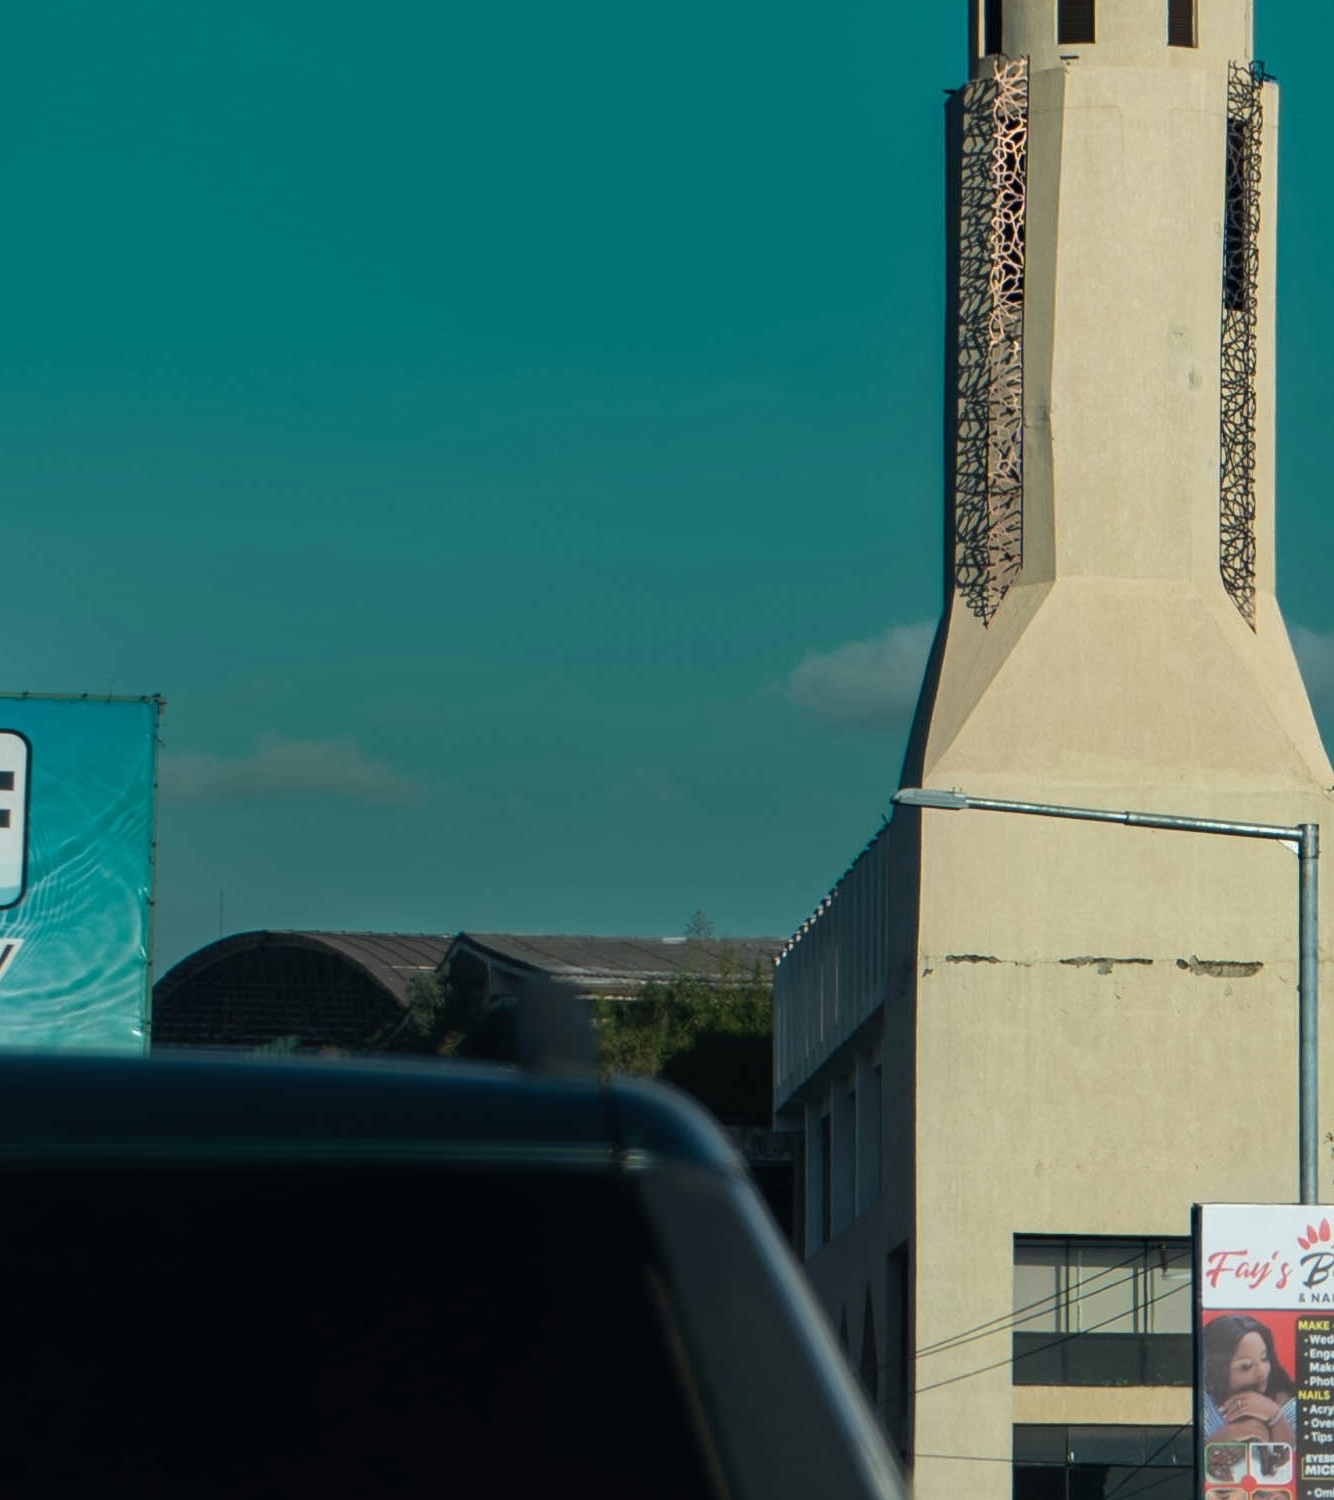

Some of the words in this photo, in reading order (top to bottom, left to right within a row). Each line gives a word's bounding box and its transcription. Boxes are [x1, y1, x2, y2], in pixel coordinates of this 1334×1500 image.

[1206, 1249, 1292, 1289] Fay's
[1299, 1293, 1306, 1303] &
[1298, 1320, 1330, 1331] MAKE
[1298, 1390, 1331, 1400] NAILS
[1310, 1432, 1333, 1444] Tips
